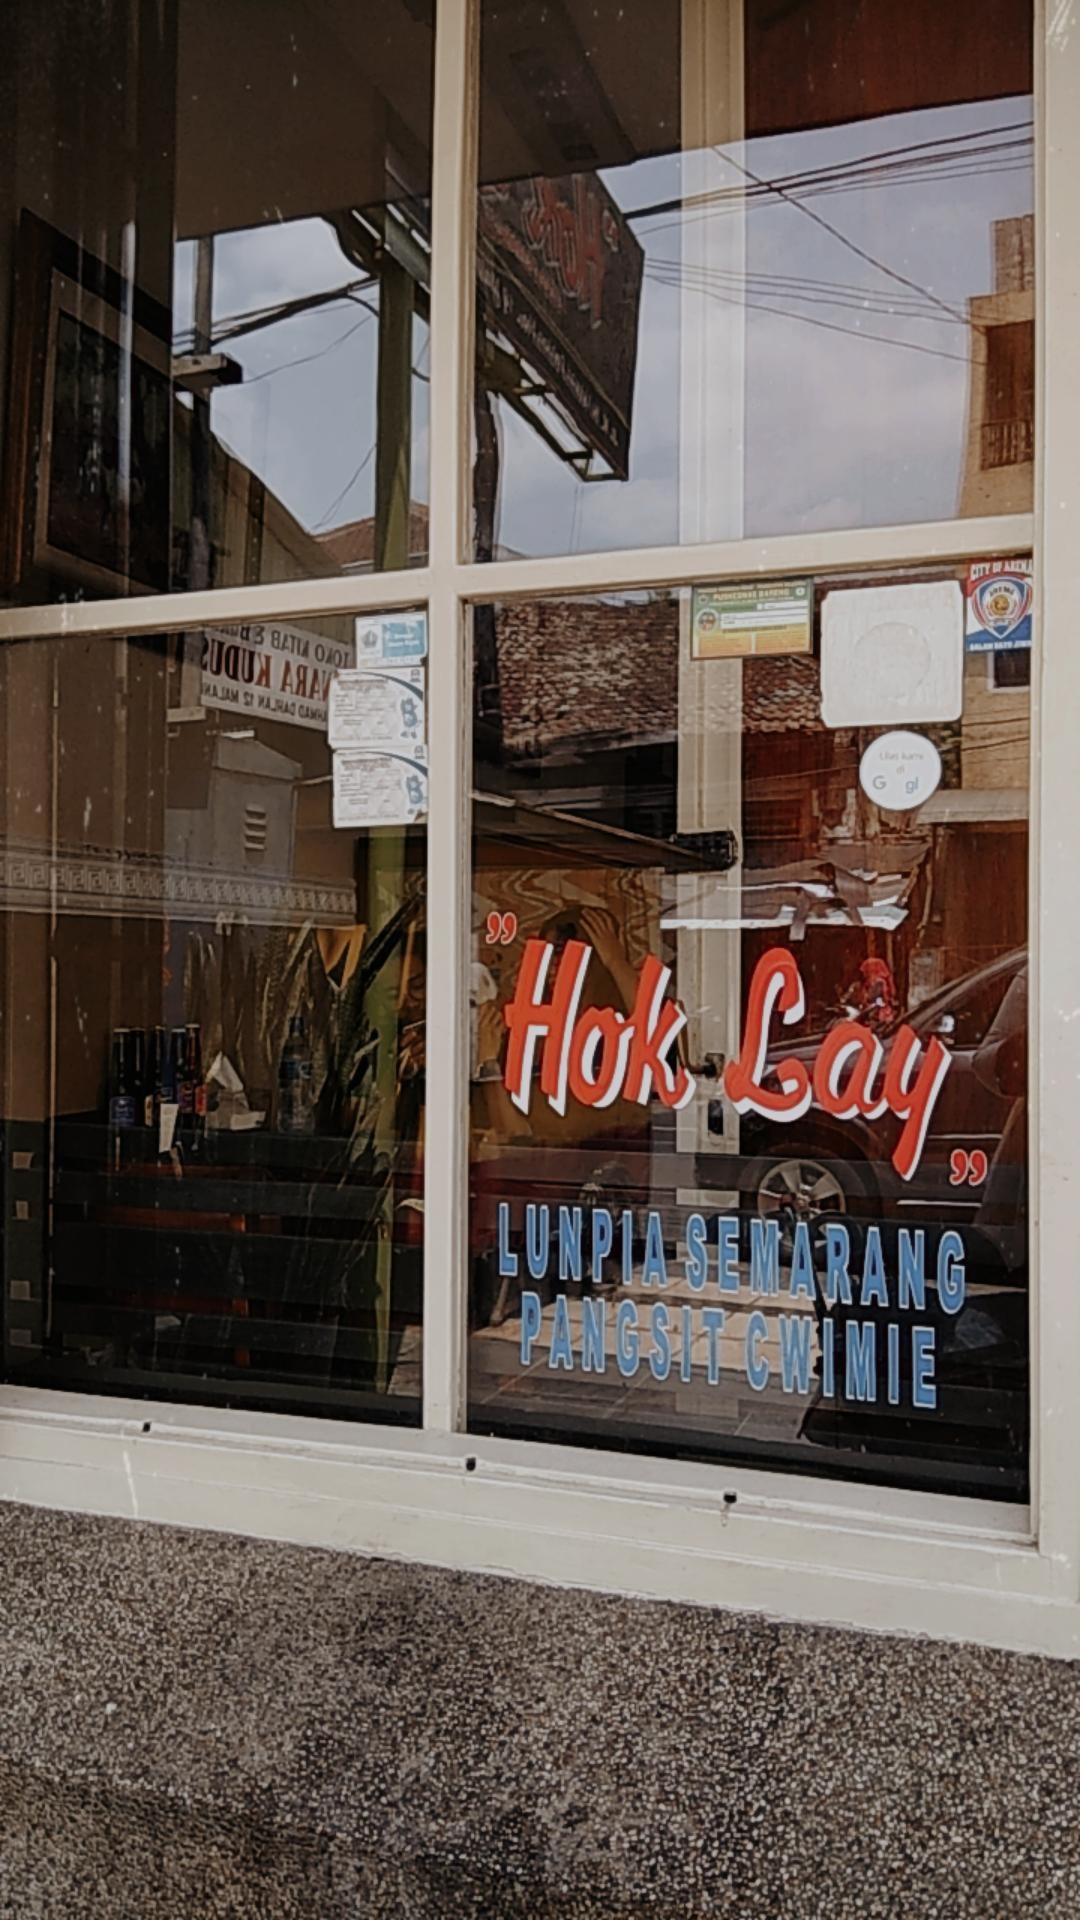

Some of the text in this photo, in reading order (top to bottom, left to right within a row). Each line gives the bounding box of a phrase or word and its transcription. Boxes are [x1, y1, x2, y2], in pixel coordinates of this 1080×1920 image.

[503, 938, 952, 1182] Hok Lay
[498, 1202, 967, 1316] LUNPIA SEMARANG
[520, 1291, 938, 1411] PANGSIT CWIMIE
